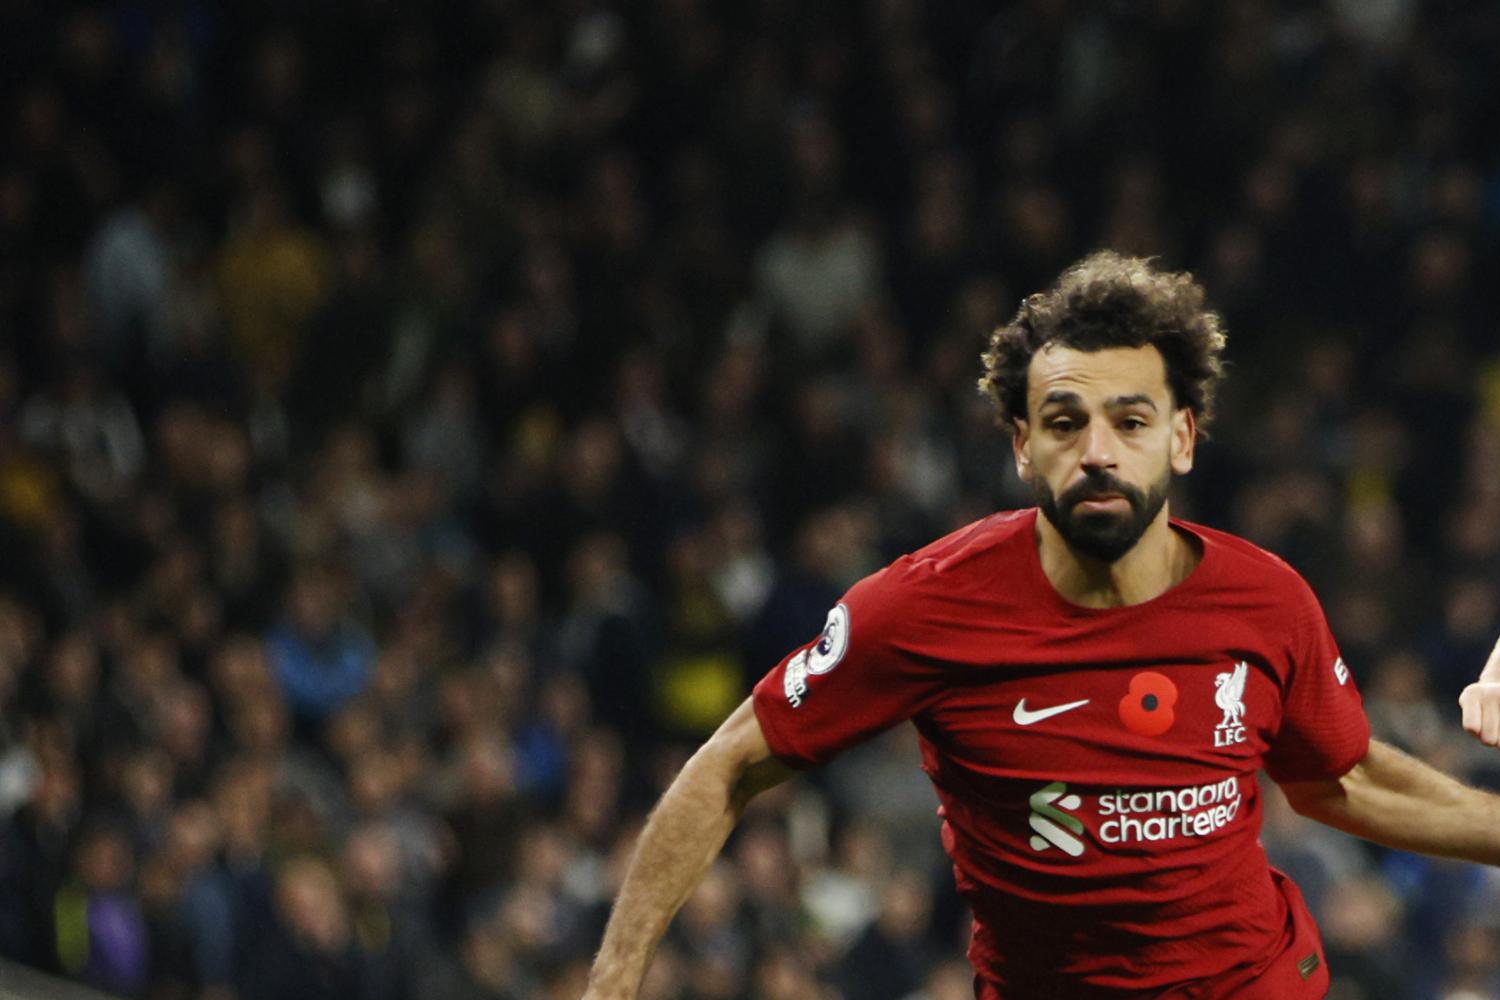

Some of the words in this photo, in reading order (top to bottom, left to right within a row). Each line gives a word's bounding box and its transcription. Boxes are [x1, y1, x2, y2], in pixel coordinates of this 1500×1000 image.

[1214, 726, 1247, 747] LFC
[1098, 776, 1238, 815] standard
[1099, 793, 1242, 843] chartered
